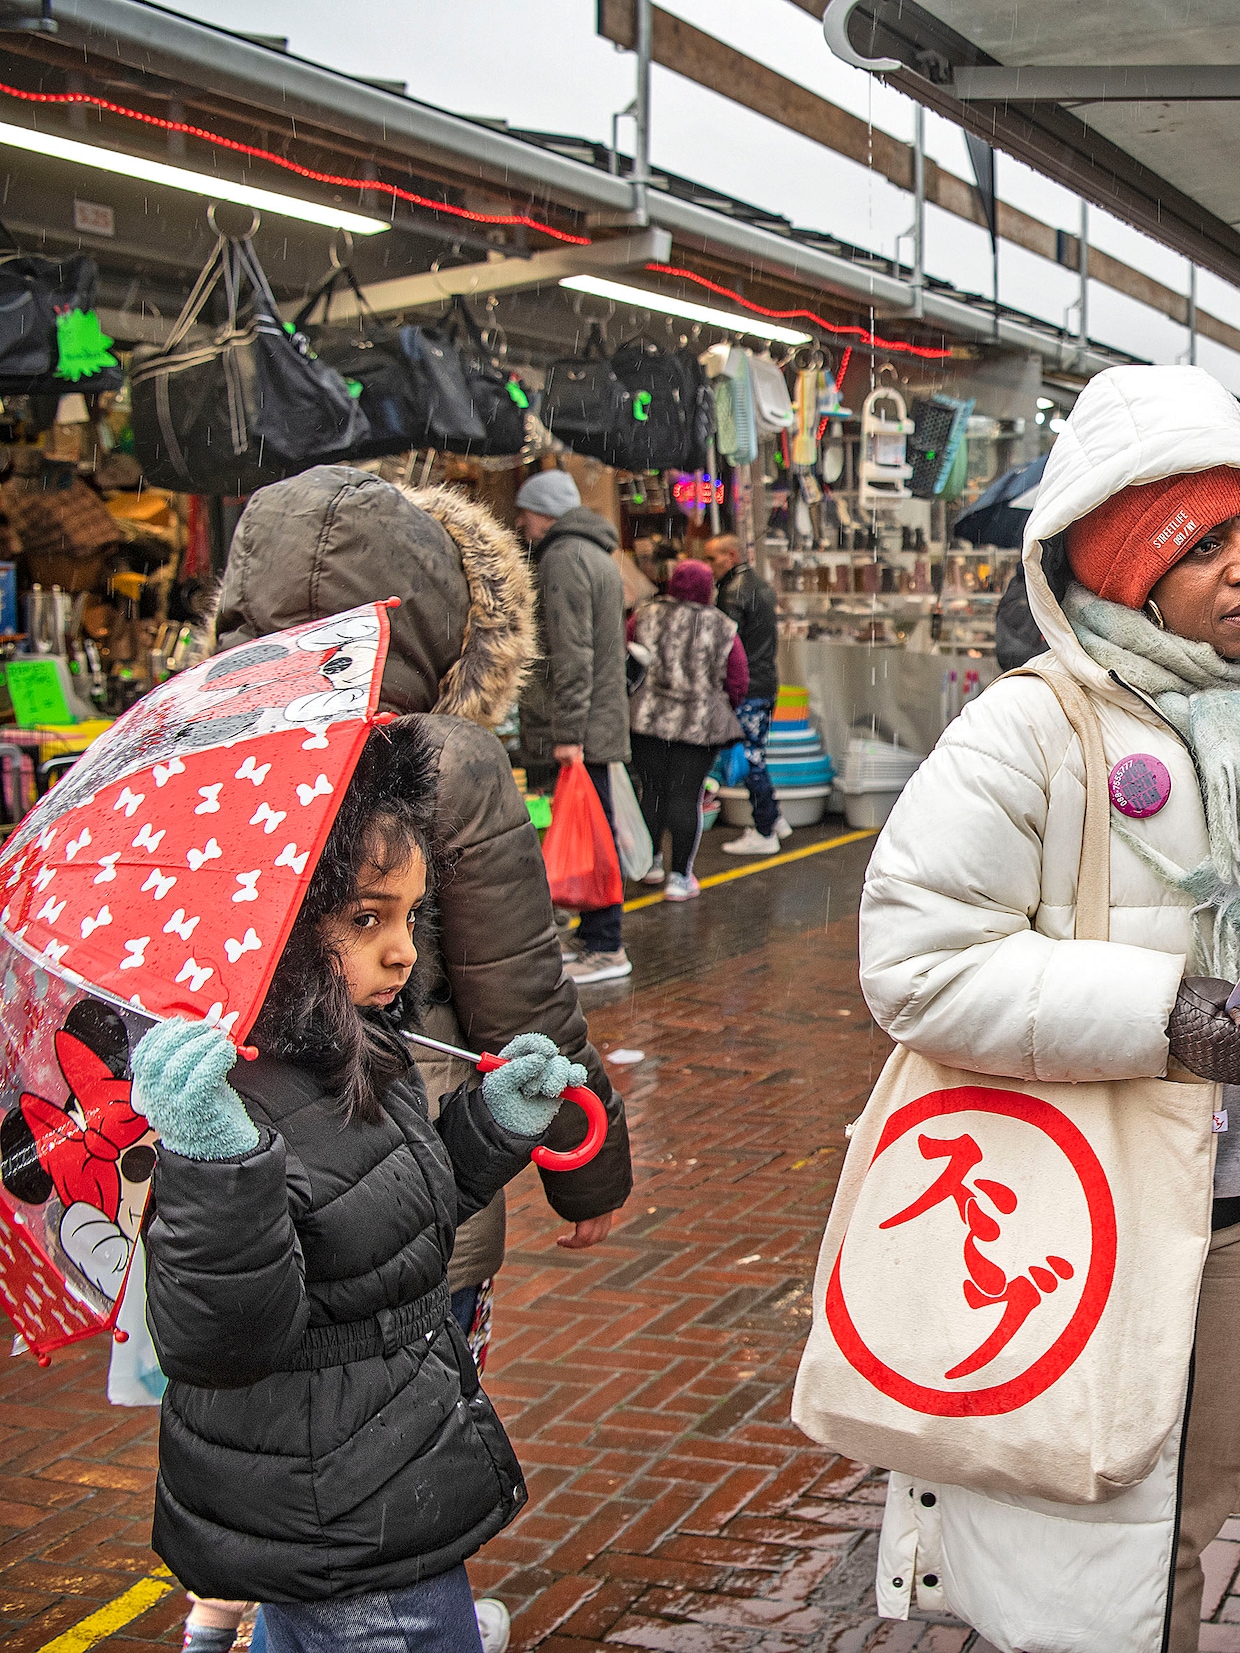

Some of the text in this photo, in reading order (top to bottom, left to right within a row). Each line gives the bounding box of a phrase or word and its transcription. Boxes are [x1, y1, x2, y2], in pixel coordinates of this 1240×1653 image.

[1153, 510, 1188, 549] STREETLIFE
[1121, 771, 1157, 801] URGENT
[1131, 786, 1162, 811] TEAM
